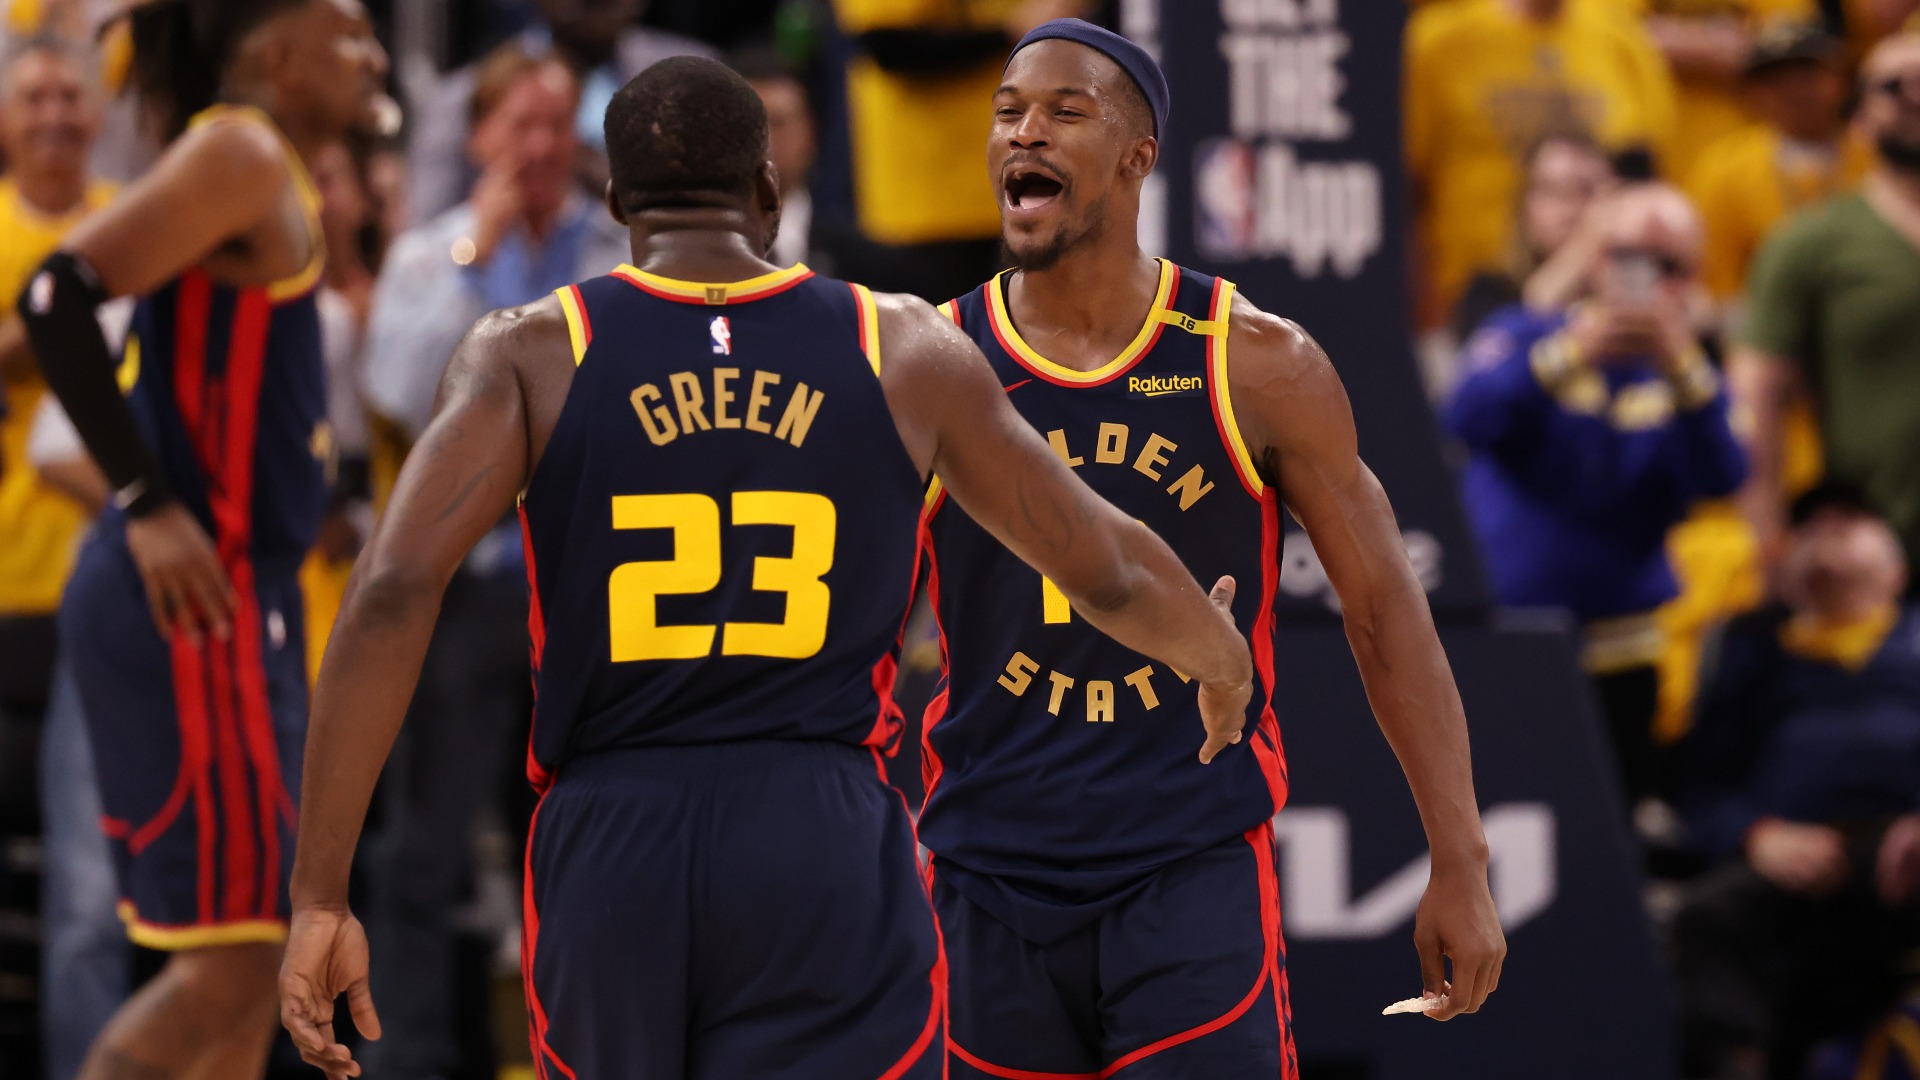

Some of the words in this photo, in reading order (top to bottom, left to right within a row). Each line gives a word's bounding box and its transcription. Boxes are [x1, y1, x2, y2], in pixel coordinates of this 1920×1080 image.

[1219, 33, 1351, 140] THE
[1256, 144, 1382, 278] App
[1179, 316, 1196, 331] 16
[629, 367, 825, 448] GREEN
[1129, 375, 1202, 393] Rakuten
[1047, 422, 1215, 512] LDEN
[608, 490, 837, 663] 23
[997, 651, 1192, 722] STAT
